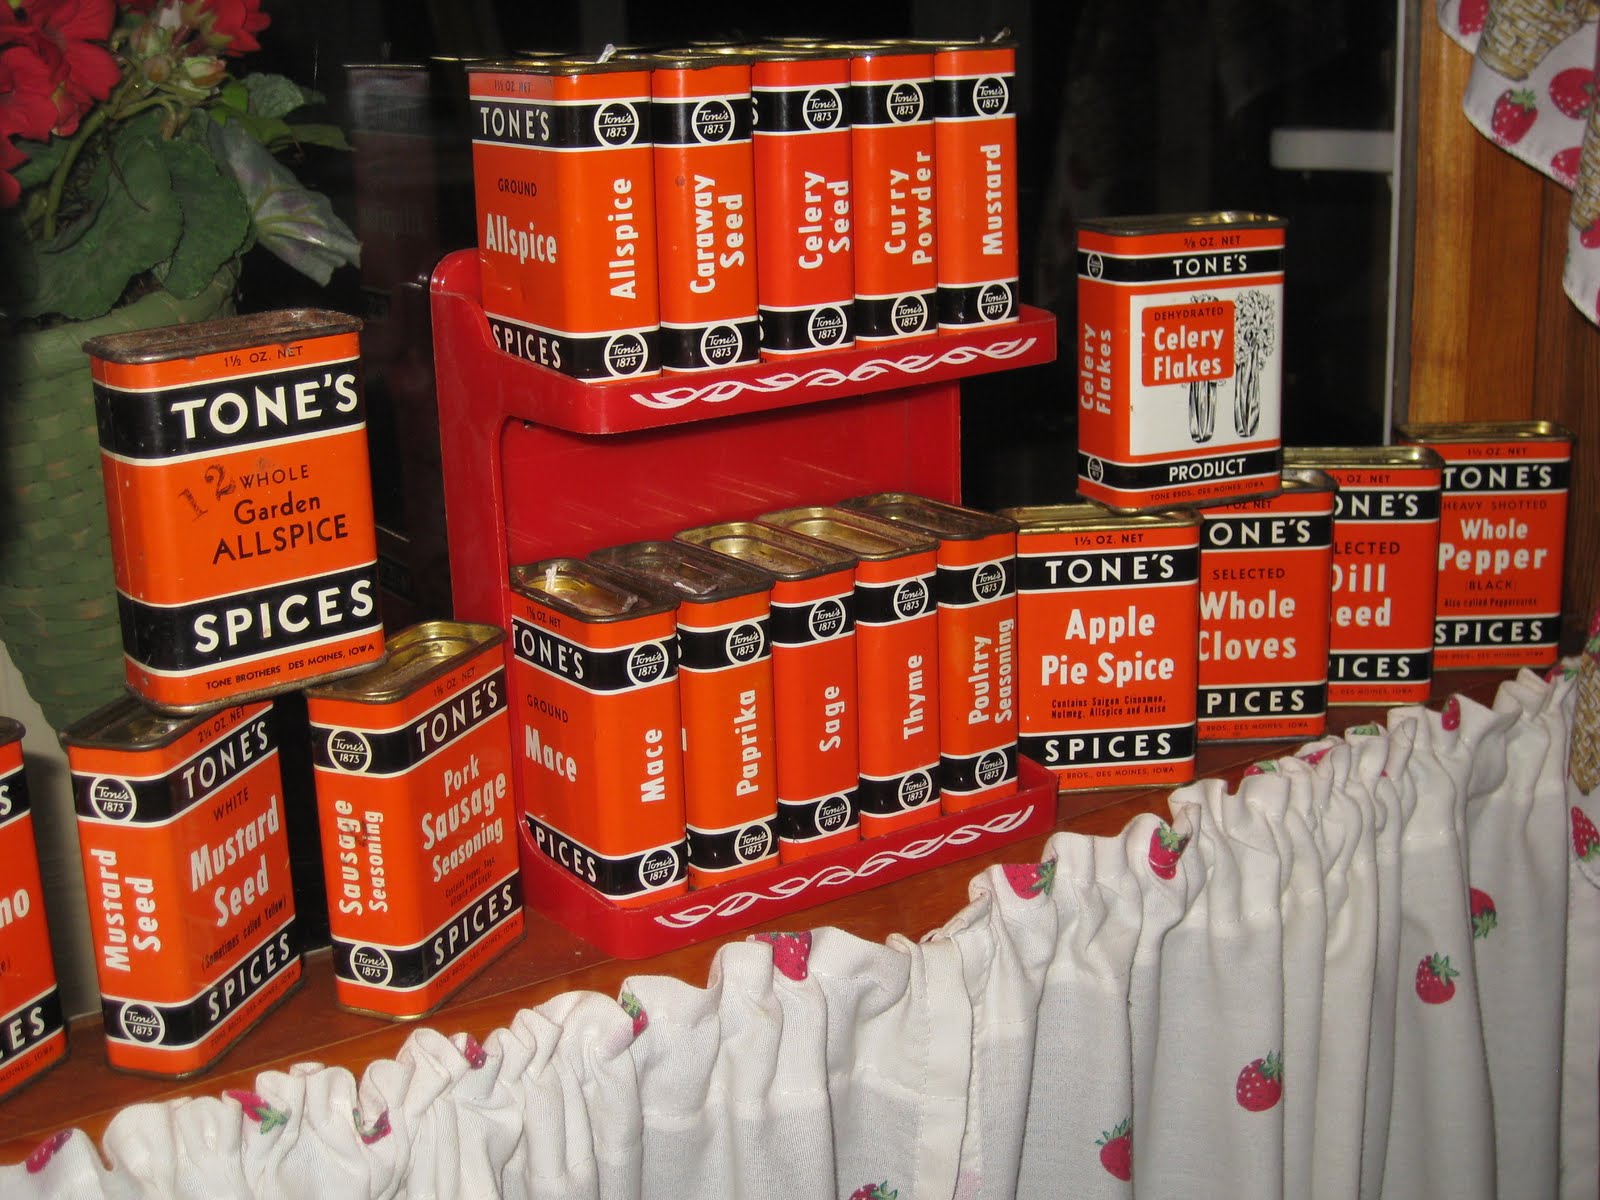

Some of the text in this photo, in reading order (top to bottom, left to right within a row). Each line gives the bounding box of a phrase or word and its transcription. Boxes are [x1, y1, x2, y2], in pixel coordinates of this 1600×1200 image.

[814, 110, 832, 122] 1873
[896, 104, 914, 115] 1873
[982, 98, 1000, 109] 1873
[480, 106, 550, 142] TONE'S
[606, 126, 628, 138] 1873
[703, 122, 725, 135] 1873
[498, 178, 537, 196] GROUND
[980, 144, 1004, 255] Mustard
[798, 170, 825, 270] Celery
[826, 180, 850, 252] Seed
[884, 169, 910, 254] Curry
[912, 151, 933, 264] Powder
[486, 213, 557, 264] Allspice
[608, 178, 638, 300] Allspice
[690, 174, 716, 294] Caraway
[718, 194, 744, 268] Seed
[1222, 236, 1240, 246] NET
[1173, 254, 1247, 276] TONE'S
[902, 316, 918, 327] 1873
[987, 302, 1004, 314] 1873
[1154, 306, 1224, 321] DEHYDRATED
[493, 324, 561, 368] SPICES
[818, 327, 837, 340] 1873
[1154, 326, 1224, 350] Celery
[249, 350, 272, 364] OZ.
[277, 345, 303, 358] NET
[616, 356, 637, 368] 1873
[712, 346, 732, 358] 1873
[1080, 324, 1096, 410] Celery
[1096, 328, 1112, 416] Flakes
[1154, 357, 1222, 380] Flakes
[170, 372, 358, 440] TONE'S
[240, 464, 309, 490] WHOLE
[1169, 458, 1246, 482] PRODUCT
[1370, 475, 1390, 484] NET
[1443, 465, 1552, 489] TONE'S
[234, 496, 320, 525] Garden
[1444, 500, 1547, 511] HEAVY SHOTTED
[212, 514, 348, 564] ALLSPICE
[1122, 534, 1144, 543] NET
[1209, 520, 1312, 546] ONE'S
[1460, 518, 1528, 540] Whole
[1334, 542, 1400, 555] LECTED
[1438, 543, 1548, 575] Pepper
[1045, 554, 1174, 585] TONE'S
[1213, 568, 1286, 580] SELECTED
[980, 582, 998, 594] 1873
[194, 578, 372, 654] SPICES
[902, 600, 920, 611] 1873
[1200, 590, 1296, 620] Whole
[1331, 597, 1392, 628] eed
[549, 616, 561, 628] NET
[818, 620, 836, 632] 1873
[1065, 606, 1155, 644] Apple
[1435, 621, 1542, 644] SPICES
[512, 623, 584, 680] TONE'S
[736, 644, 754, 656] 1873
[1199, 630, 1296, 661] Cloves
[206, 644, 374, 690] TONE BROTHERS DES MOINES, IOWA
[638, 664, 658, 677] 1873
[968, 635, 992, 726] Poultry
[994, 618, 1014, 724] Seasoning
[1042, 651, 1174, 688] Pie Spice
[527, 694, 568, 724] GROUND
[904, 655, 926, 740] Thyme
[1052, 699, 1088, 708] Contains
[1092, 697, 1120, 707] Saigon
[1090, 708, 1122, 717] Allspice
[1127, 706, 1140, 714] and
[1144, 704, 1166, 713] Anise
[1206, 690, 1304, 714] PICES
[230, 706, 244, 722] NET
[416, 681, 498, 753] TONE'S
[820, 686, 846, 752] Sage
[525, 725, 577, 782] Mace
[734, 689, 762, 796] Paprika
[1045, 732, 1171, 762] SPICES
[183, 721, 268, 799] TONE'S
[339, 752, 360, 764] 1873
[640, 728, 666, 802] Mace
[444, 754, 480, 797] Pork
[984, 769, 1000, 780] 1873
[1096, 770, 1111, 778] DES
[102, 800, 126, 813] 1873
[214, 788, 250, 822] WHITE
[907, 792, 924, 802] 1873
[421, 772, 506, 852] Sausage
[824, 816, 842, 826] 1873
[190, 795, 280, 892] Mustard
[335, 800, 362, 916] Sausage
[432, 816, 504, 882] Seasoning
[527, 821, 597, 883] PICES
[744, 844, 762, 856] 1873
[364, 811, 388, 912] Seasoning
[650, 868, 668, 881] 1873
[214, 856, 268, 928] Seed
[90, 848, 132, 972] Mustard
[125, 878, 161, 953] Seed
[243, 914, 261, 939] called
[434, 884, 512, 966] SPICES
[208, 933, 290, 1021] SPICES
[361, 966, 382, 978] 1873
[132, 1024, 154, 1037] 1873
